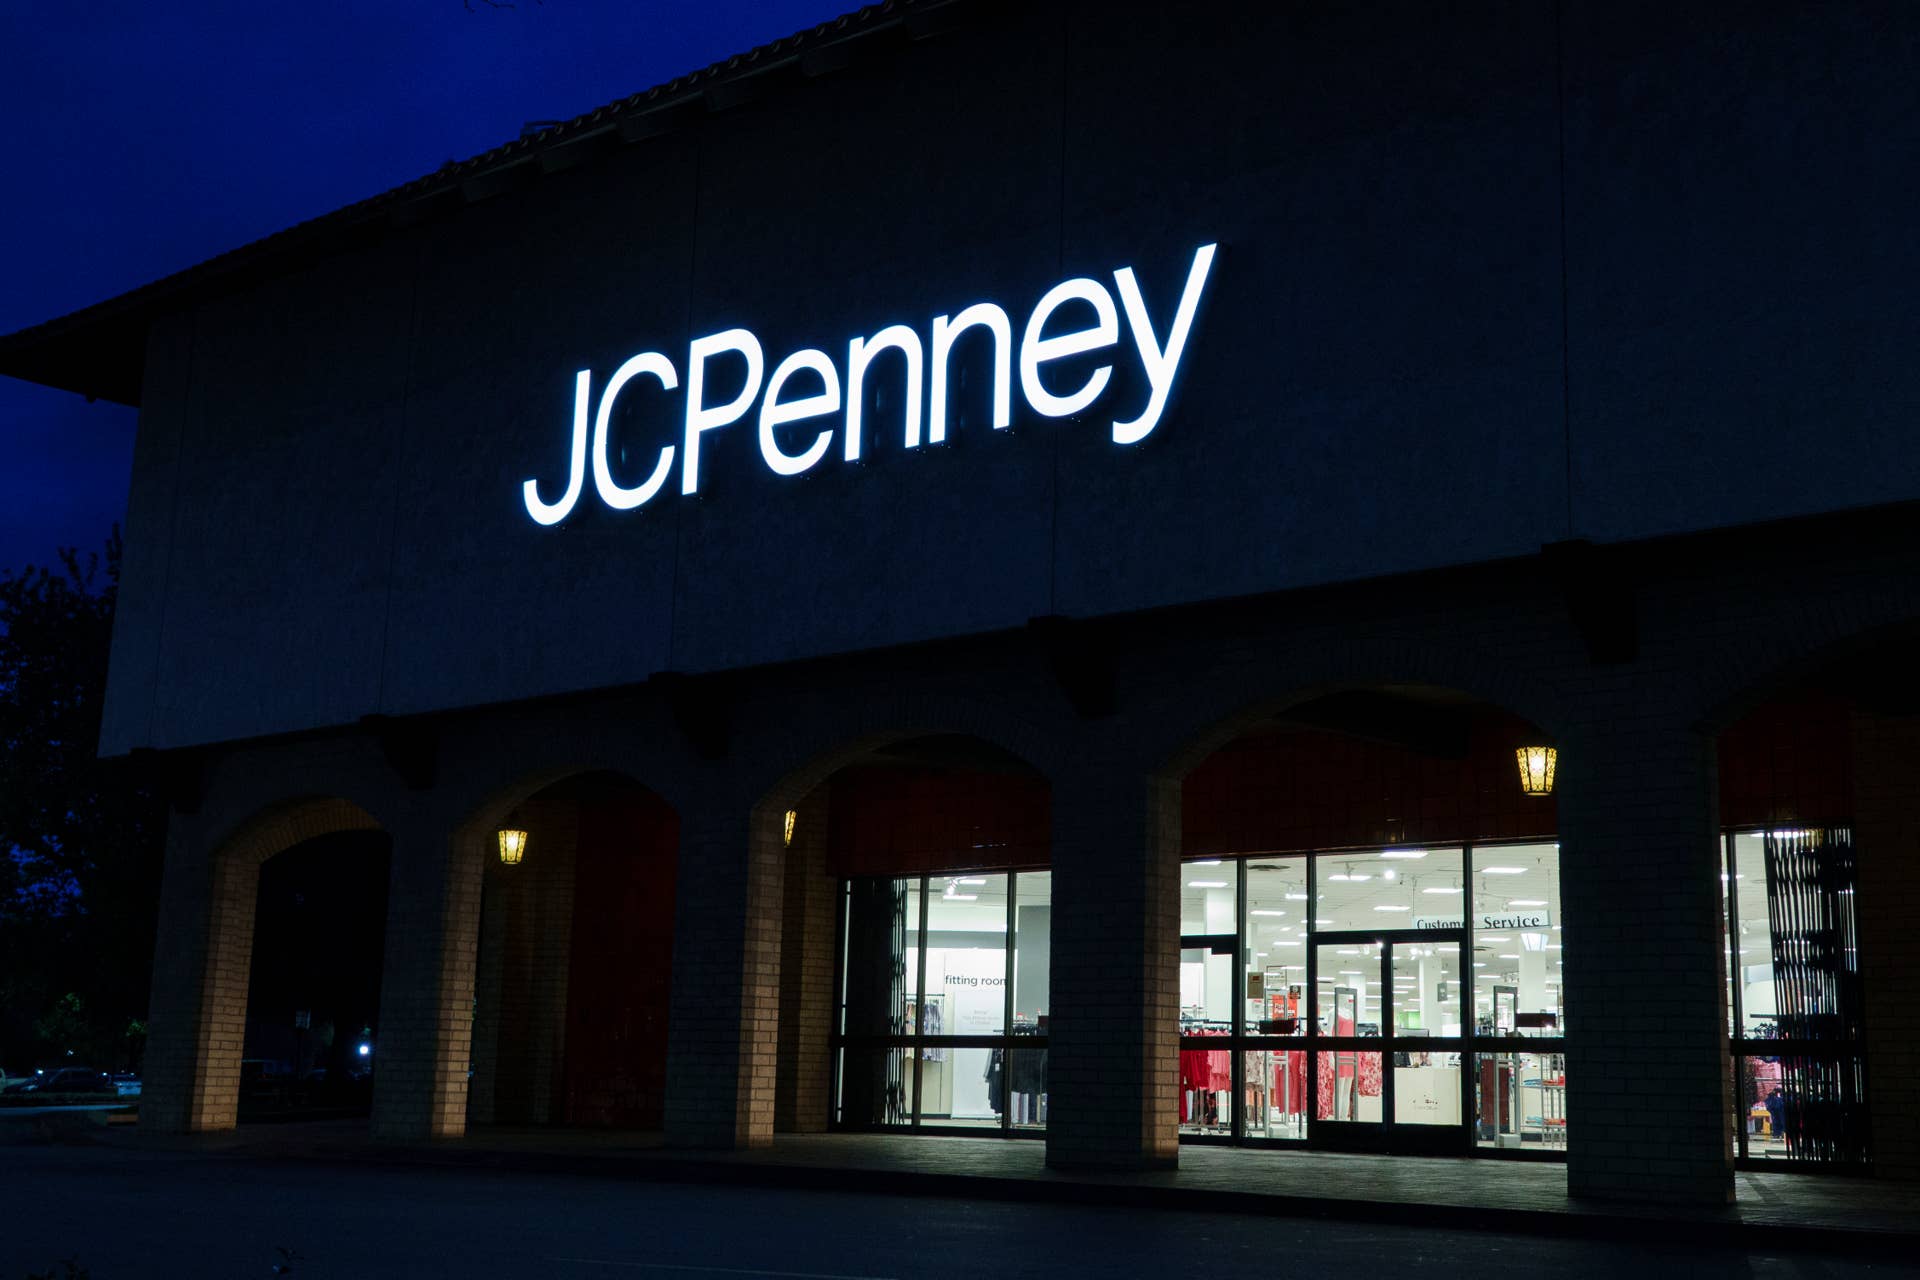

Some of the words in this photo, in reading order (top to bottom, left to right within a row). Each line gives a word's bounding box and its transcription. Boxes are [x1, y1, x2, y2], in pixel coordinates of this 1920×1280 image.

[522, 242, 1217, 526] JCPenney
[1416, 919, 1465, 929] Custom
[1484, 915, 1540, 929] Service
[945, 975, 977, 987] fitting
